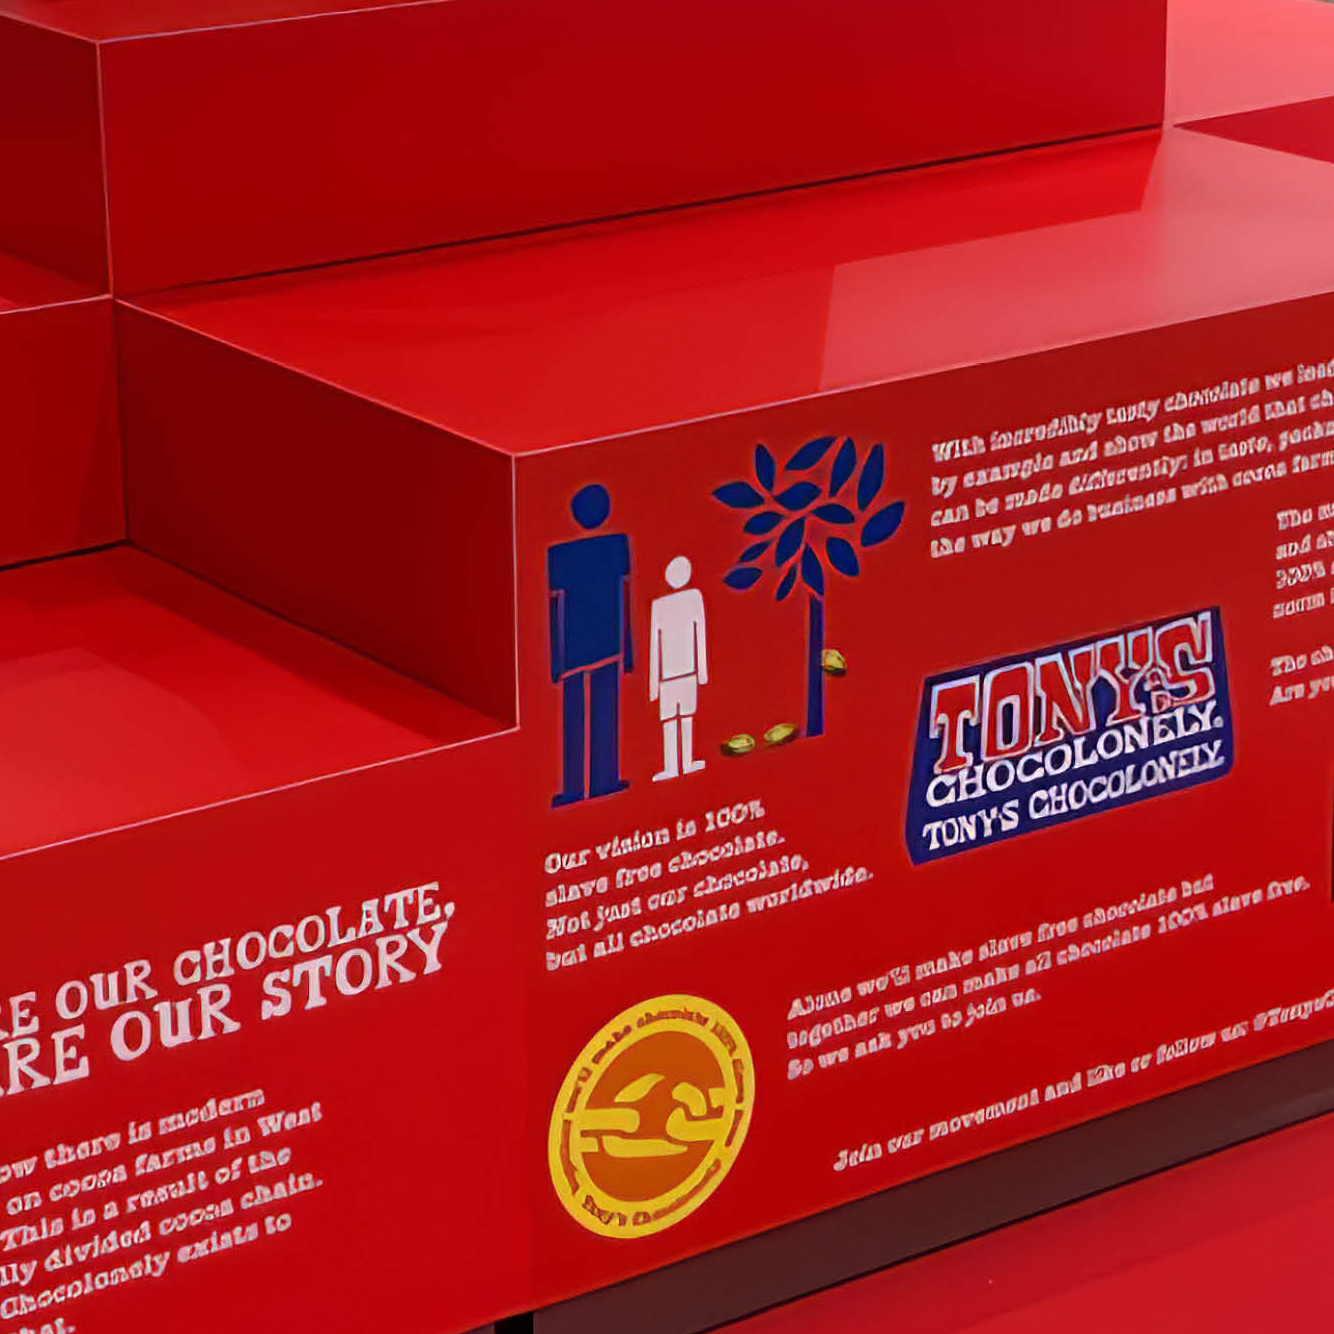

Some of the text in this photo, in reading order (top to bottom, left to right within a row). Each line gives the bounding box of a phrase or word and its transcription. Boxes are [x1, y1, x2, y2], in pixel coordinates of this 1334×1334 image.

[56, 960, 157, 1019] OUR
[174, 882, 454, 985] CHOCOLATE,
[111, 984, 240, 1060] OUR
[262, 921, 447, 1019] STORY
